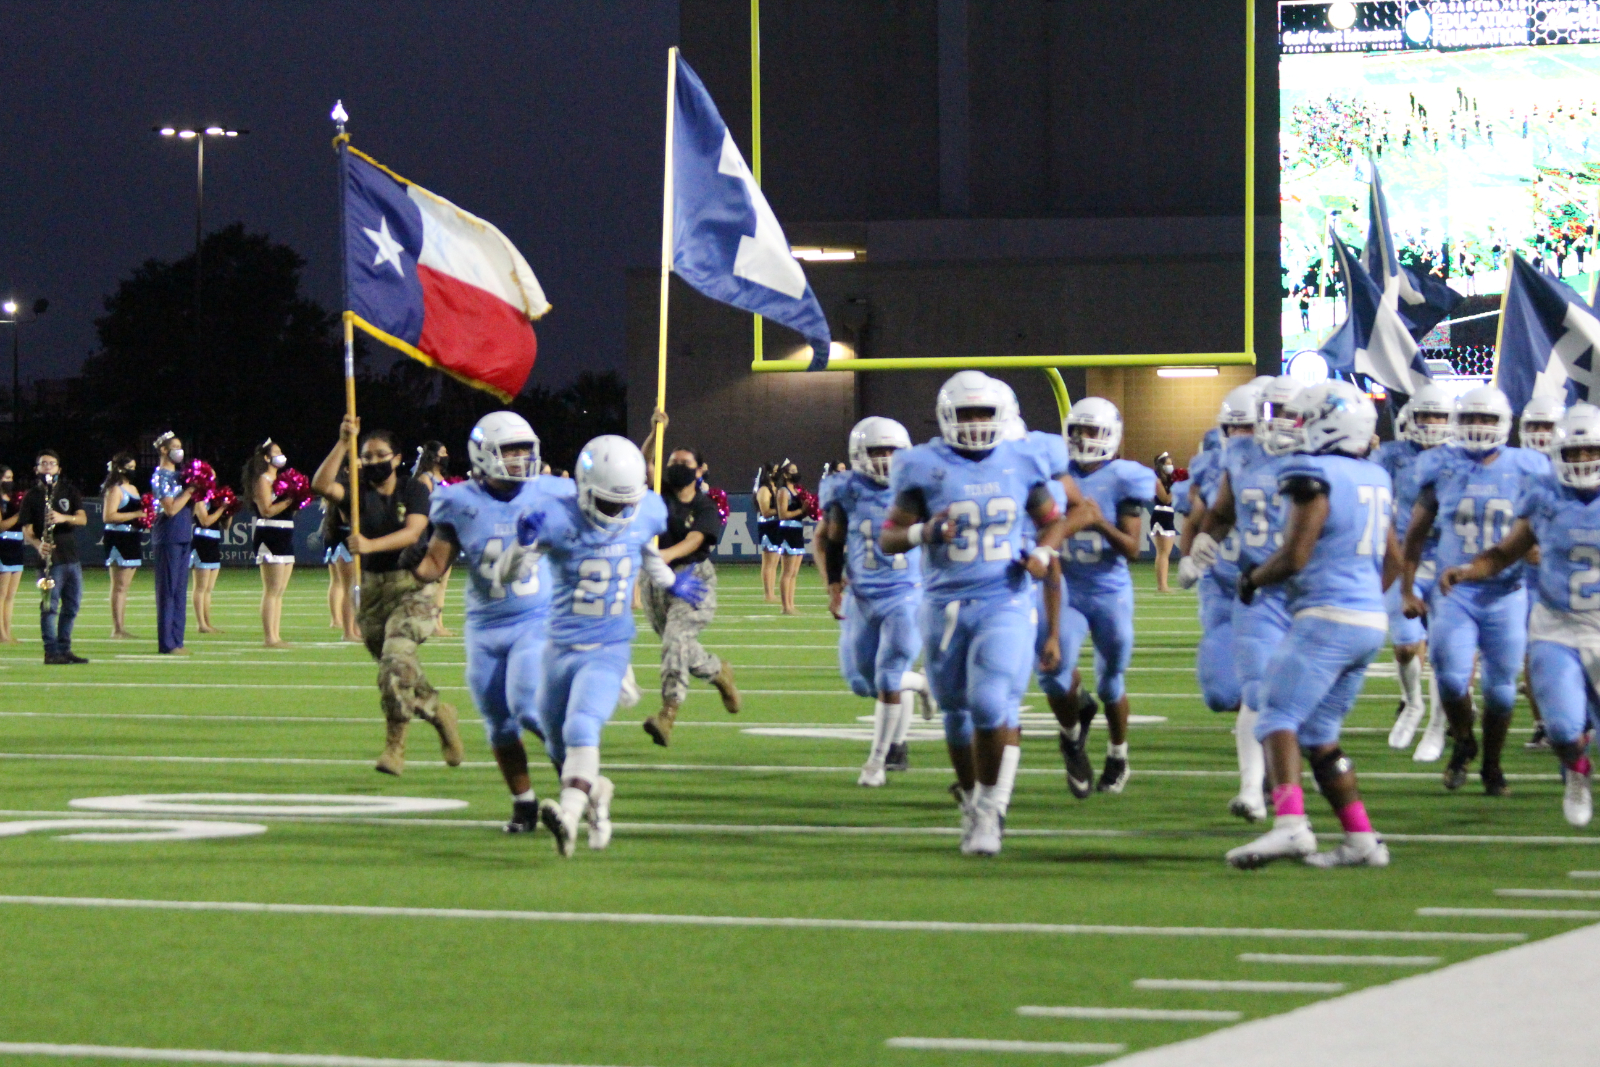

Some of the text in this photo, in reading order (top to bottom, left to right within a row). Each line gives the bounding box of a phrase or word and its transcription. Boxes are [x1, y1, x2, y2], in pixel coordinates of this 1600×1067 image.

[1431, 10, 1528, 29] EDUCATION
[1282, 29, 1310, 45] Gulf
[1431, 26, 1528, 47] FOUNDATION
[1282, 42, 1402, 53] FEDERAL CREDIT UNION
[947, 497, 1017, 562] 32
[1454, 498, 1514, 554] 40
[572, 556, 632, 616] 21
